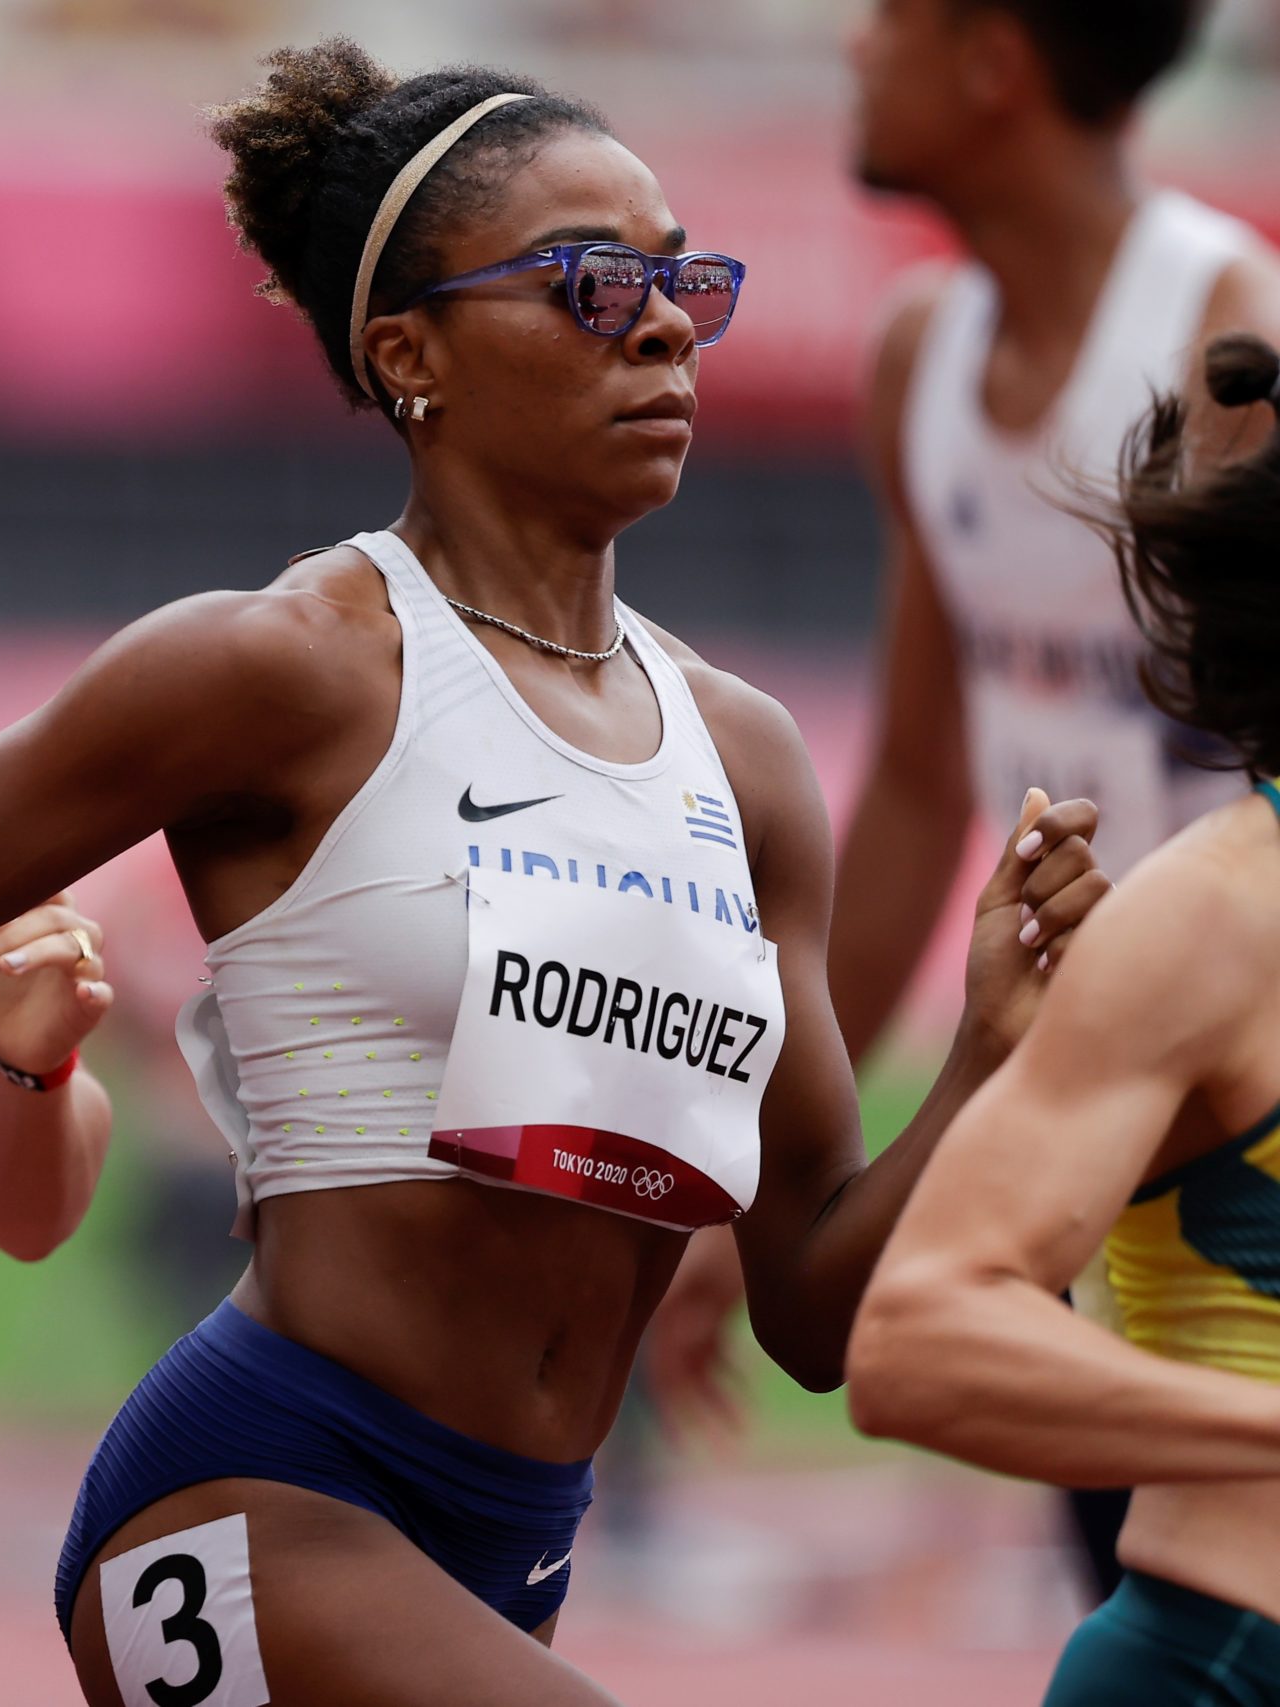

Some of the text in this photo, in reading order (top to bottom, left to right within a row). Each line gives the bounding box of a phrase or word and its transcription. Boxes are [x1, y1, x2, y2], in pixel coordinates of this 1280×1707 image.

[489, 949, 768, 1083] RODRIGUEZ
[553, 1148, 628, 1185] TOKYO 2020
[132, 1553, 223, 1707] 3
